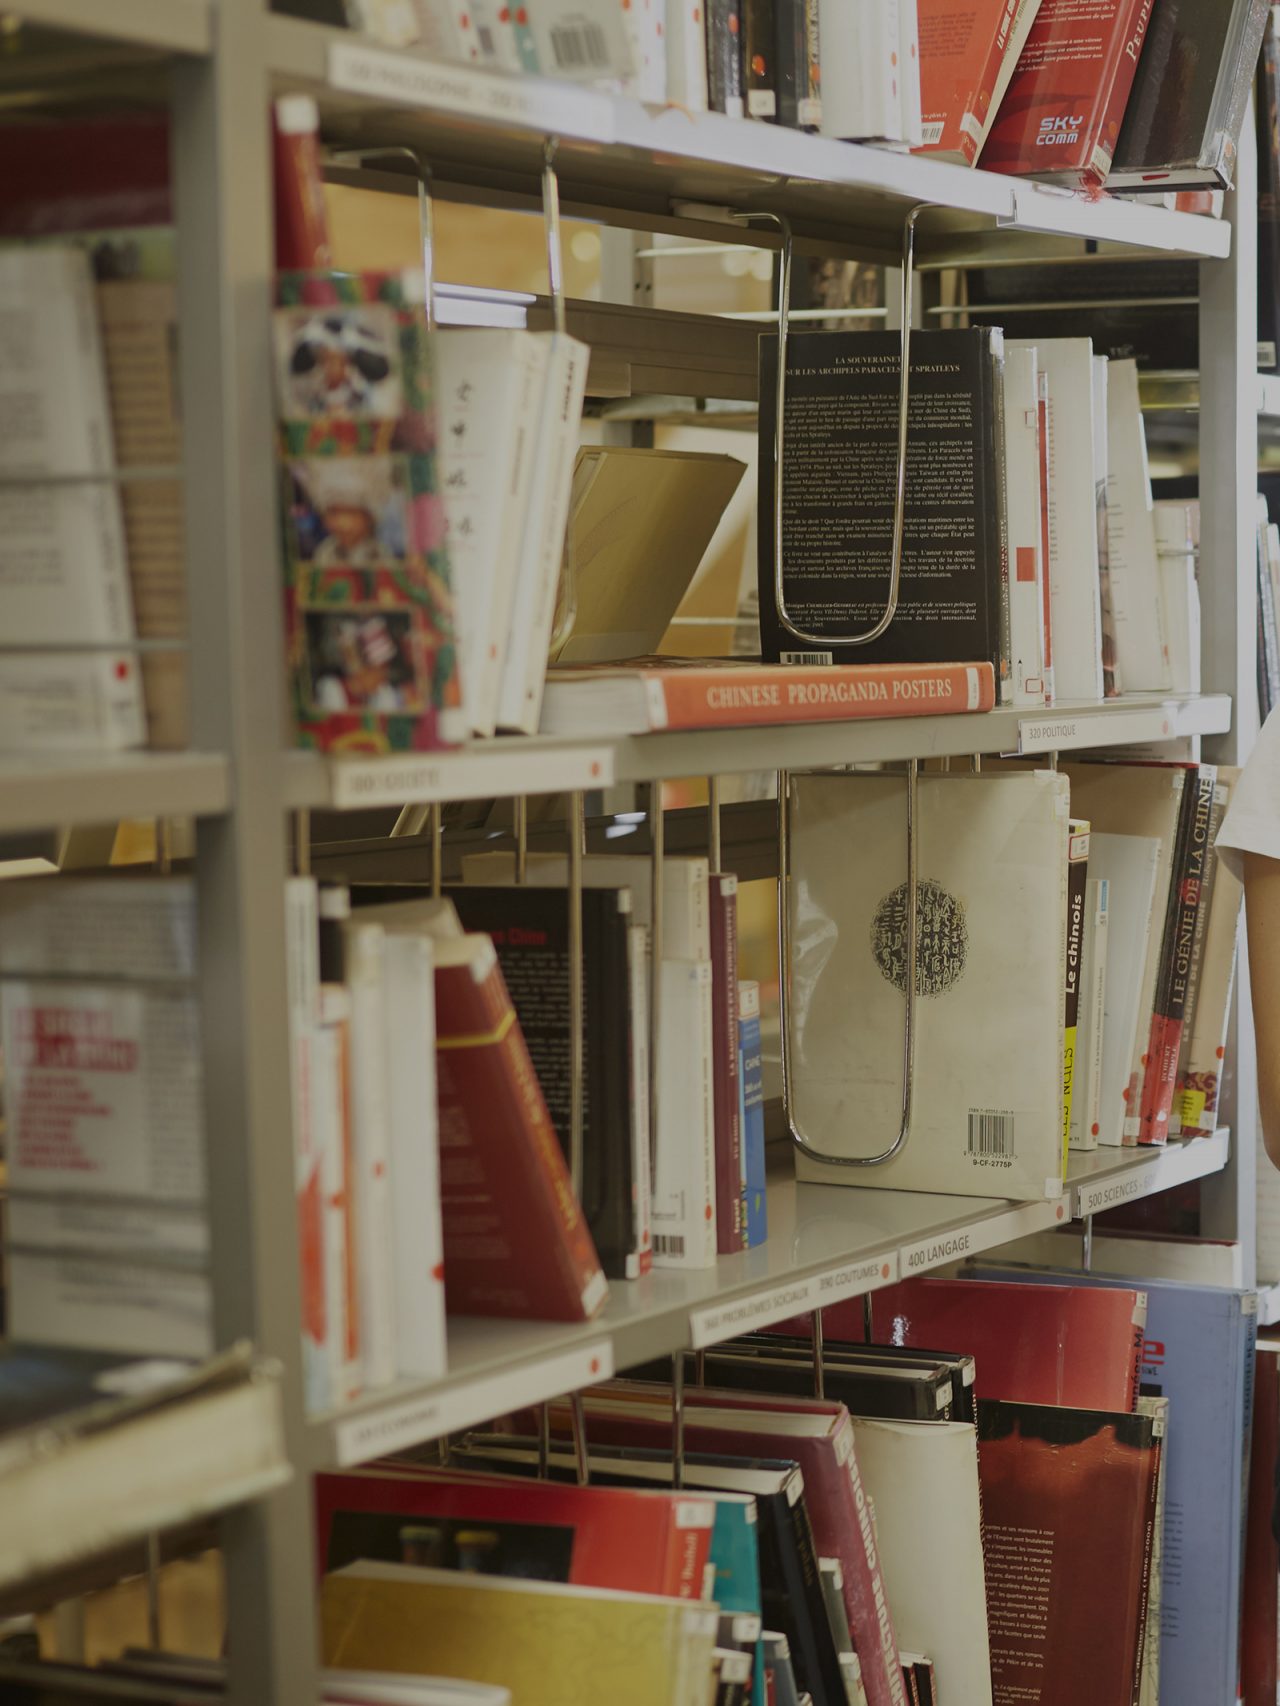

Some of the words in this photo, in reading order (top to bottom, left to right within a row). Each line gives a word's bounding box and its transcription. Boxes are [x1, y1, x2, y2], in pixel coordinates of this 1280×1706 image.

[1039, 115, 1083, 132] SKY
[1036, 132, 1078, 146] COMM
[802, 368, 816, 376] LES
[818, 367, 860, 375] ARCHIPELS
[861, 366, 901, 374] PARACELS
[916, 364, 960, 373] SPRATLEYS
[847, 355, 901, 364] SOUVERAINET
[706, 684, 780, 710] CHINESE
[788, 680, 888, 705] PROPAGANDA
[892, 678, 953, 699] POSTERS
[1029, 728, 1042, 739] 320
[1042, 724, 1076, 738] POLITIQUE
[1193, 778, 1214, 844] CHINE
[1188, 848, 1204, 875] LA
[1184, 878, 1200, 906] DE
[1068, 894, 1082, 964] chinois
[1174, 910, 1196, 975] GÉNIE
[1065, 968, 1076, 994] Le
[1172, 978, 1186, 1003] LE
[1088, 1191, 1103, 1208] 500
[1104, 1179, 1138, 1204] SCIENCES
[732, 1199, 741, 1234] fayard
[908, 1248, 926, 1268] 400
[927, 1234, 970, 1262] LANGAGE
[834, 1264, 880, 1288] COUTUMES
[1143, 1520, 1152, 1588] (1996-2006)
